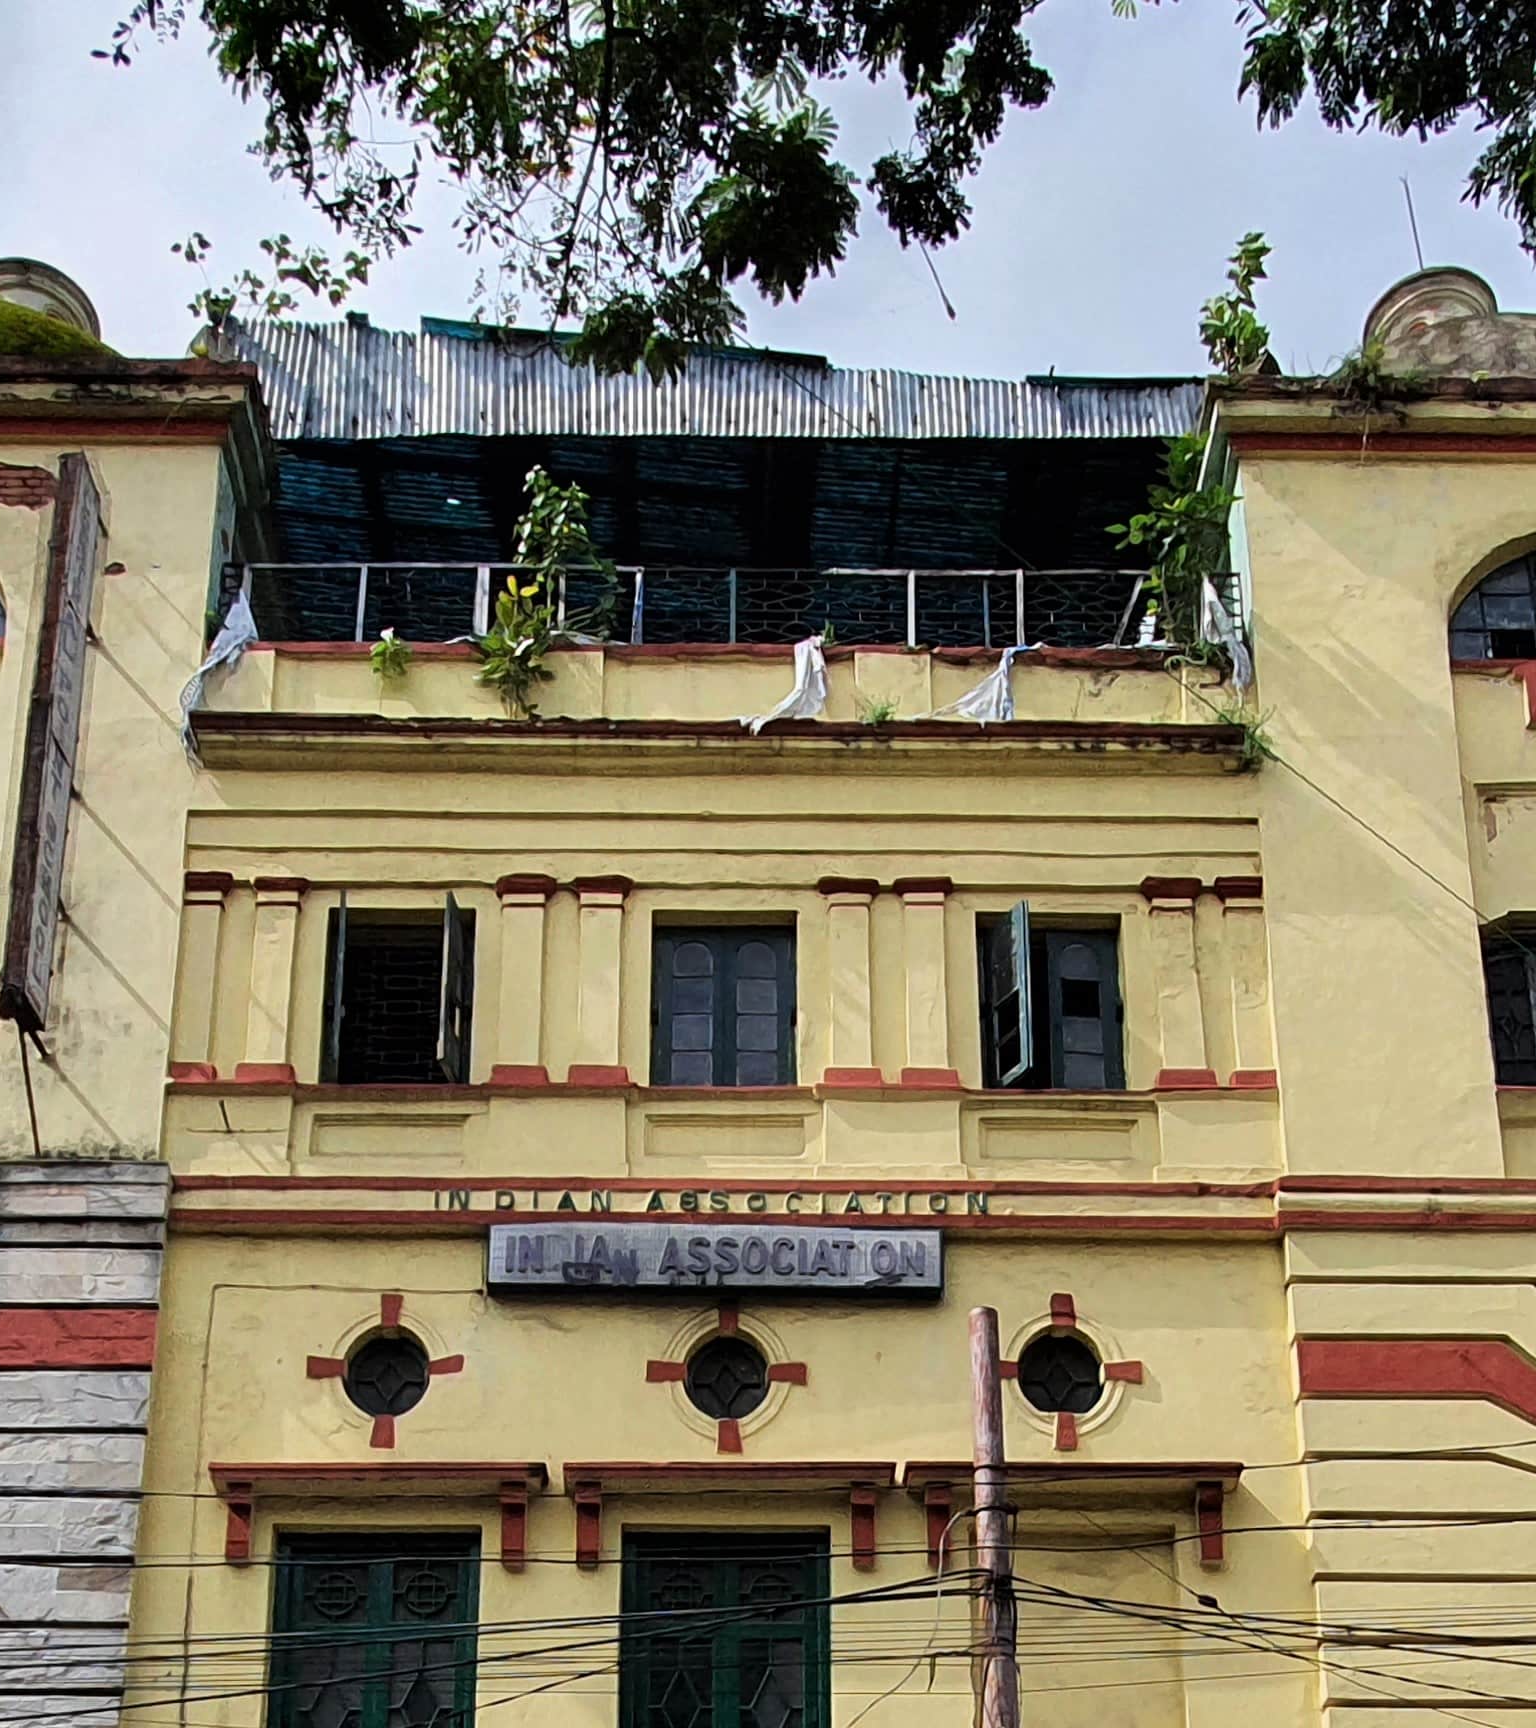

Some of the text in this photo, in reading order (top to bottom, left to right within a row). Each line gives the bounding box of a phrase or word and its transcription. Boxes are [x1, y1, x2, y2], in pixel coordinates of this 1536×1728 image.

[433, 1190, 988, 1214] INDIAN ASSOCIATION
[505, 1234, 927, 1284] INIAN ASSOCIATON
